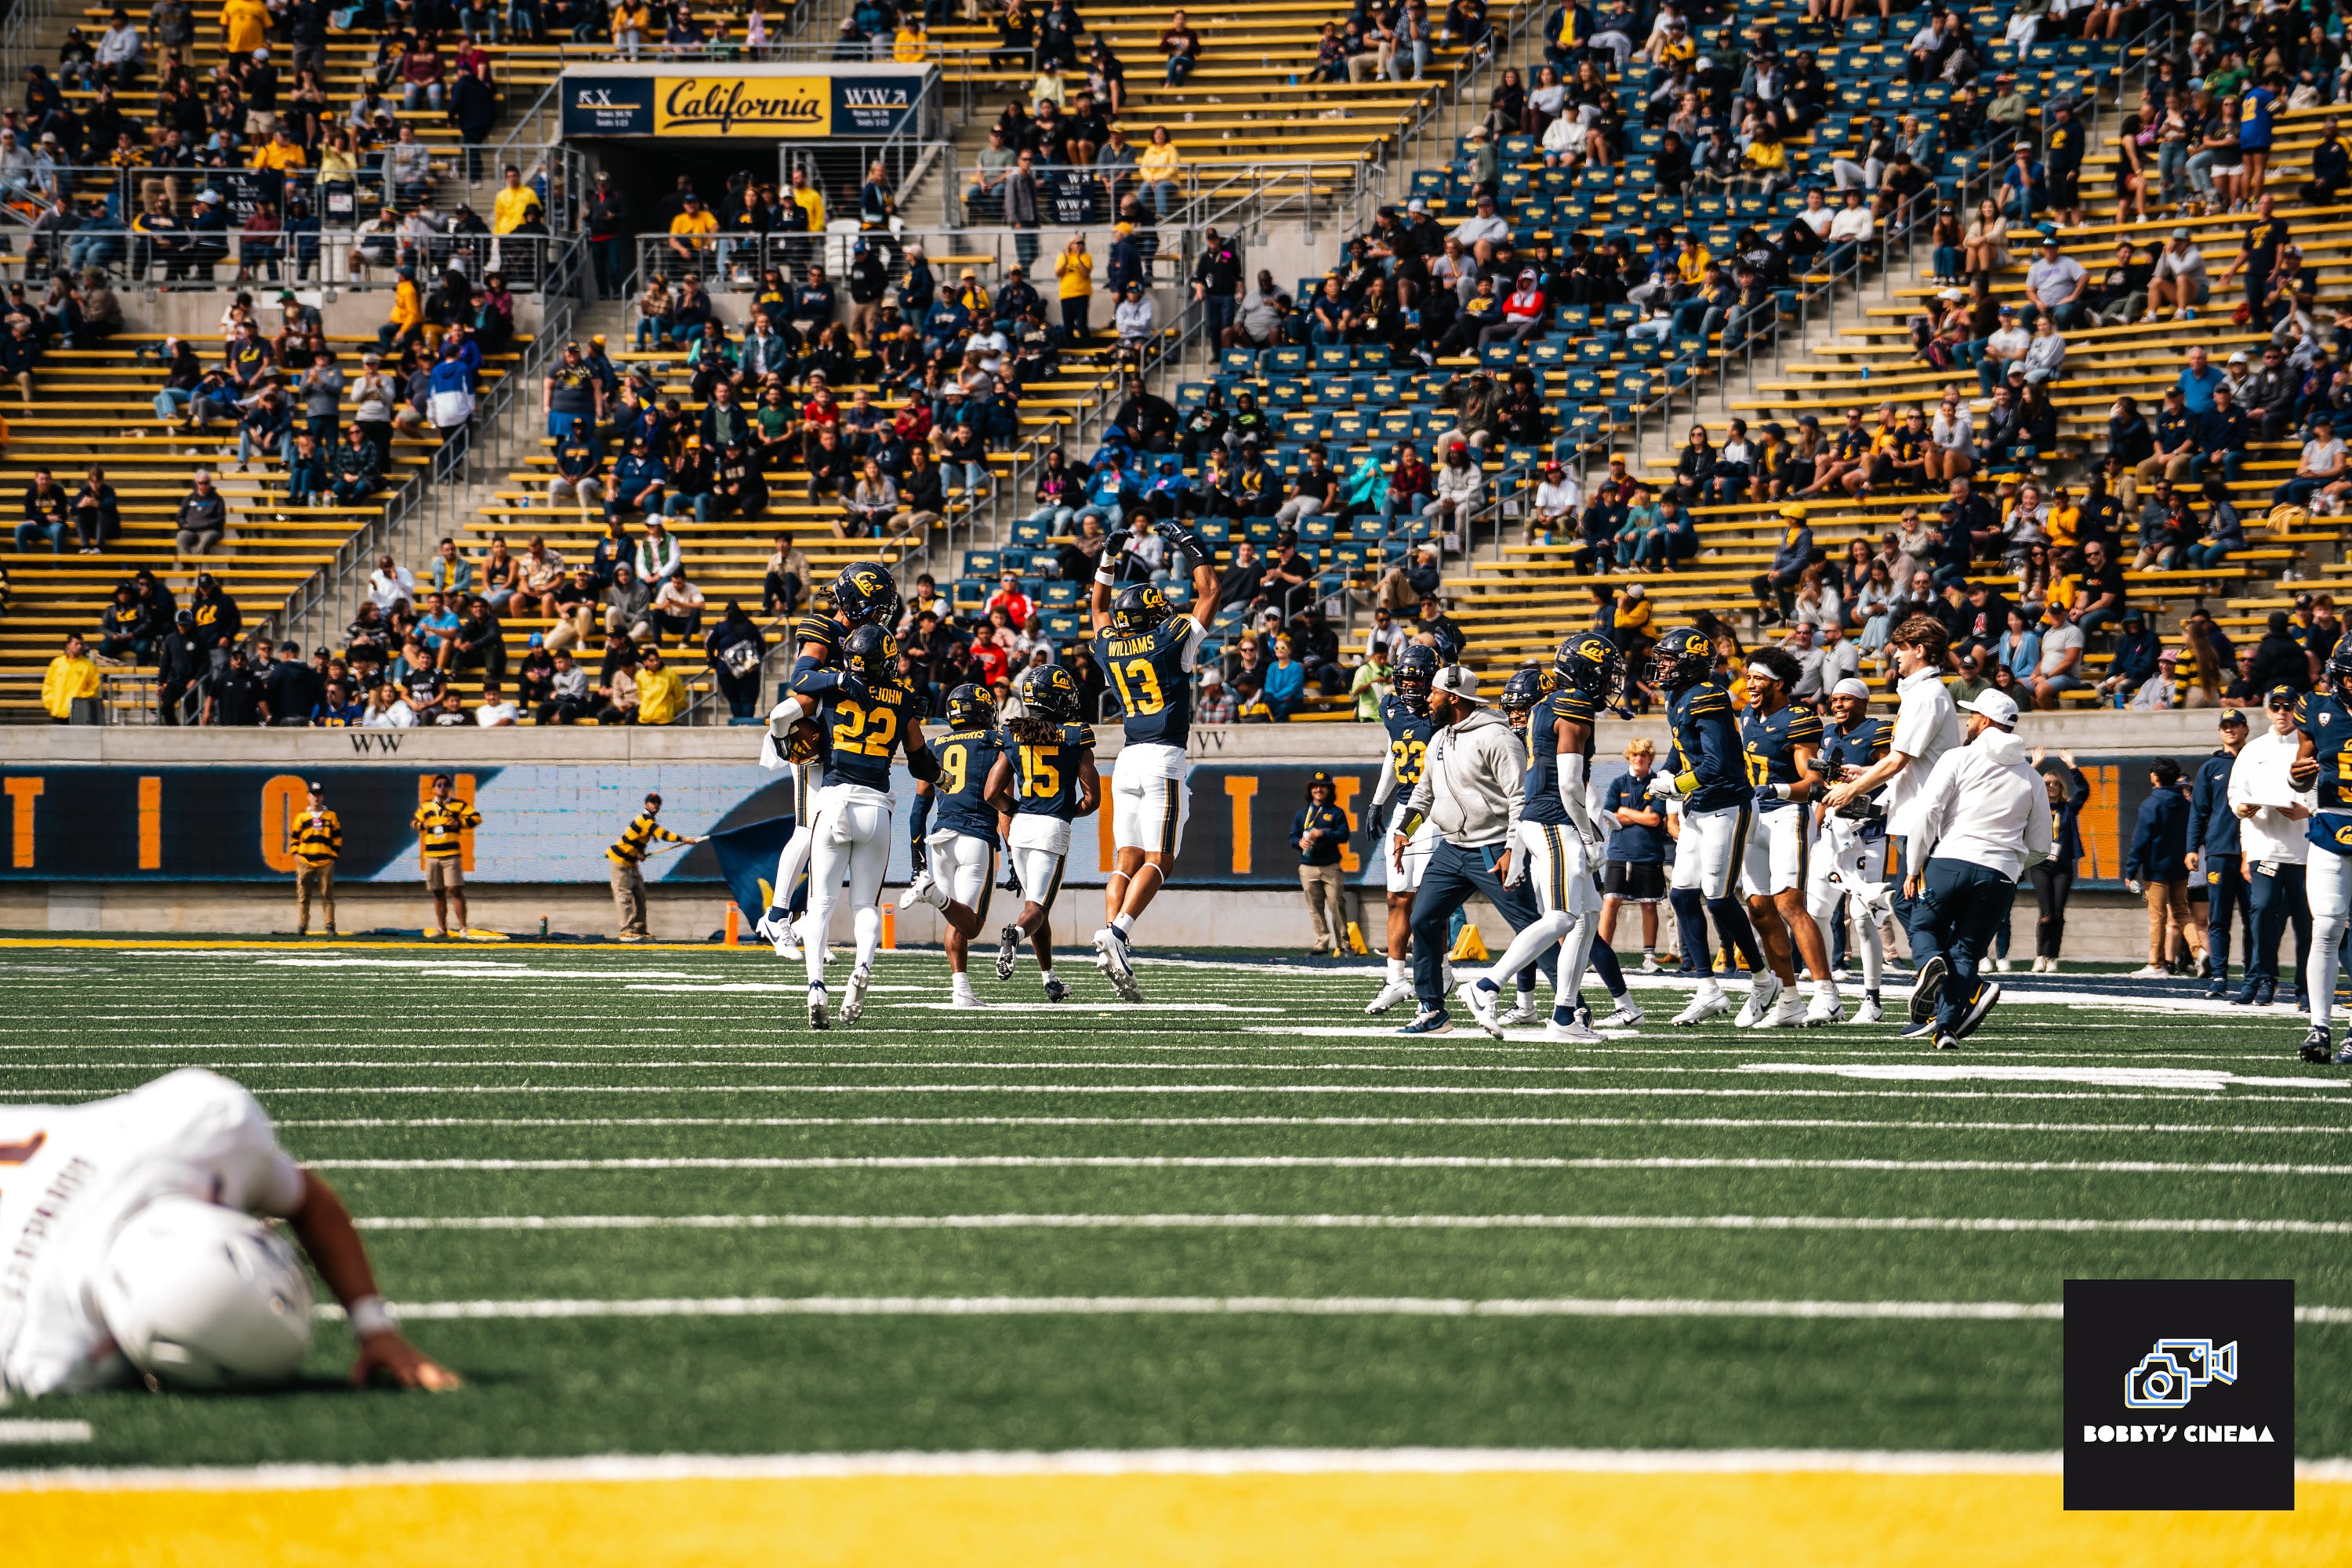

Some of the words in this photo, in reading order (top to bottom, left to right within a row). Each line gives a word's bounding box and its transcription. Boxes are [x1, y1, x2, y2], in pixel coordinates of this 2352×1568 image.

[665, 79, 824, 134] California
[844, 88, 891, 105] WW
[1142, 589, 1167, 609] Cal
[1108, 635, 1156, 657] WILLIAMS
[1686, 635, 1709, 656] Cal
[1109, 658, 1165, 718] 13
[350, 733, 405, 754] WW
[833, 699, 897, 757] 22
[943, 743, 967, 795] 9
[1019, 745, 1059, 798] 15
[1392, 739, 1428, 785] 23
